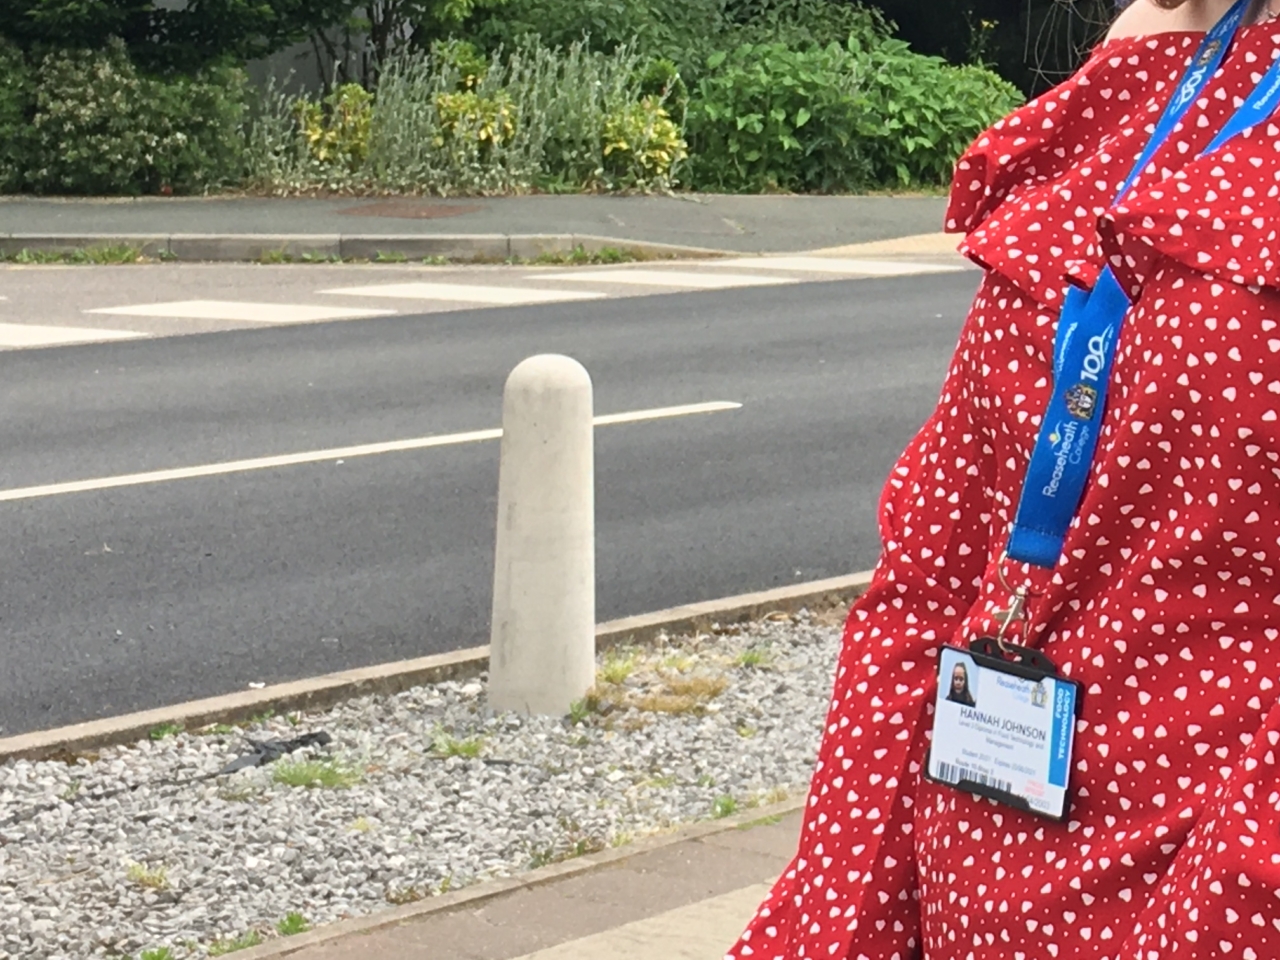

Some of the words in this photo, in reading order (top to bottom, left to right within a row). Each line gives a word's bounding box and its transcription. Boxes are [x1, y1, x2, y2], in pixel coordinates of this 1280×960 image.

[1080, 334, 1106, 382] 100
[1041, 420, 1079, 498] Reaseheath
[960, 706, 1000, 728] HANNAH
[1001, 719, 1047, 742] JOHNSON
[1055, 687, 1064, 719] FOOD
[1058, 689, 1072, 760] TECHNOLOGY
